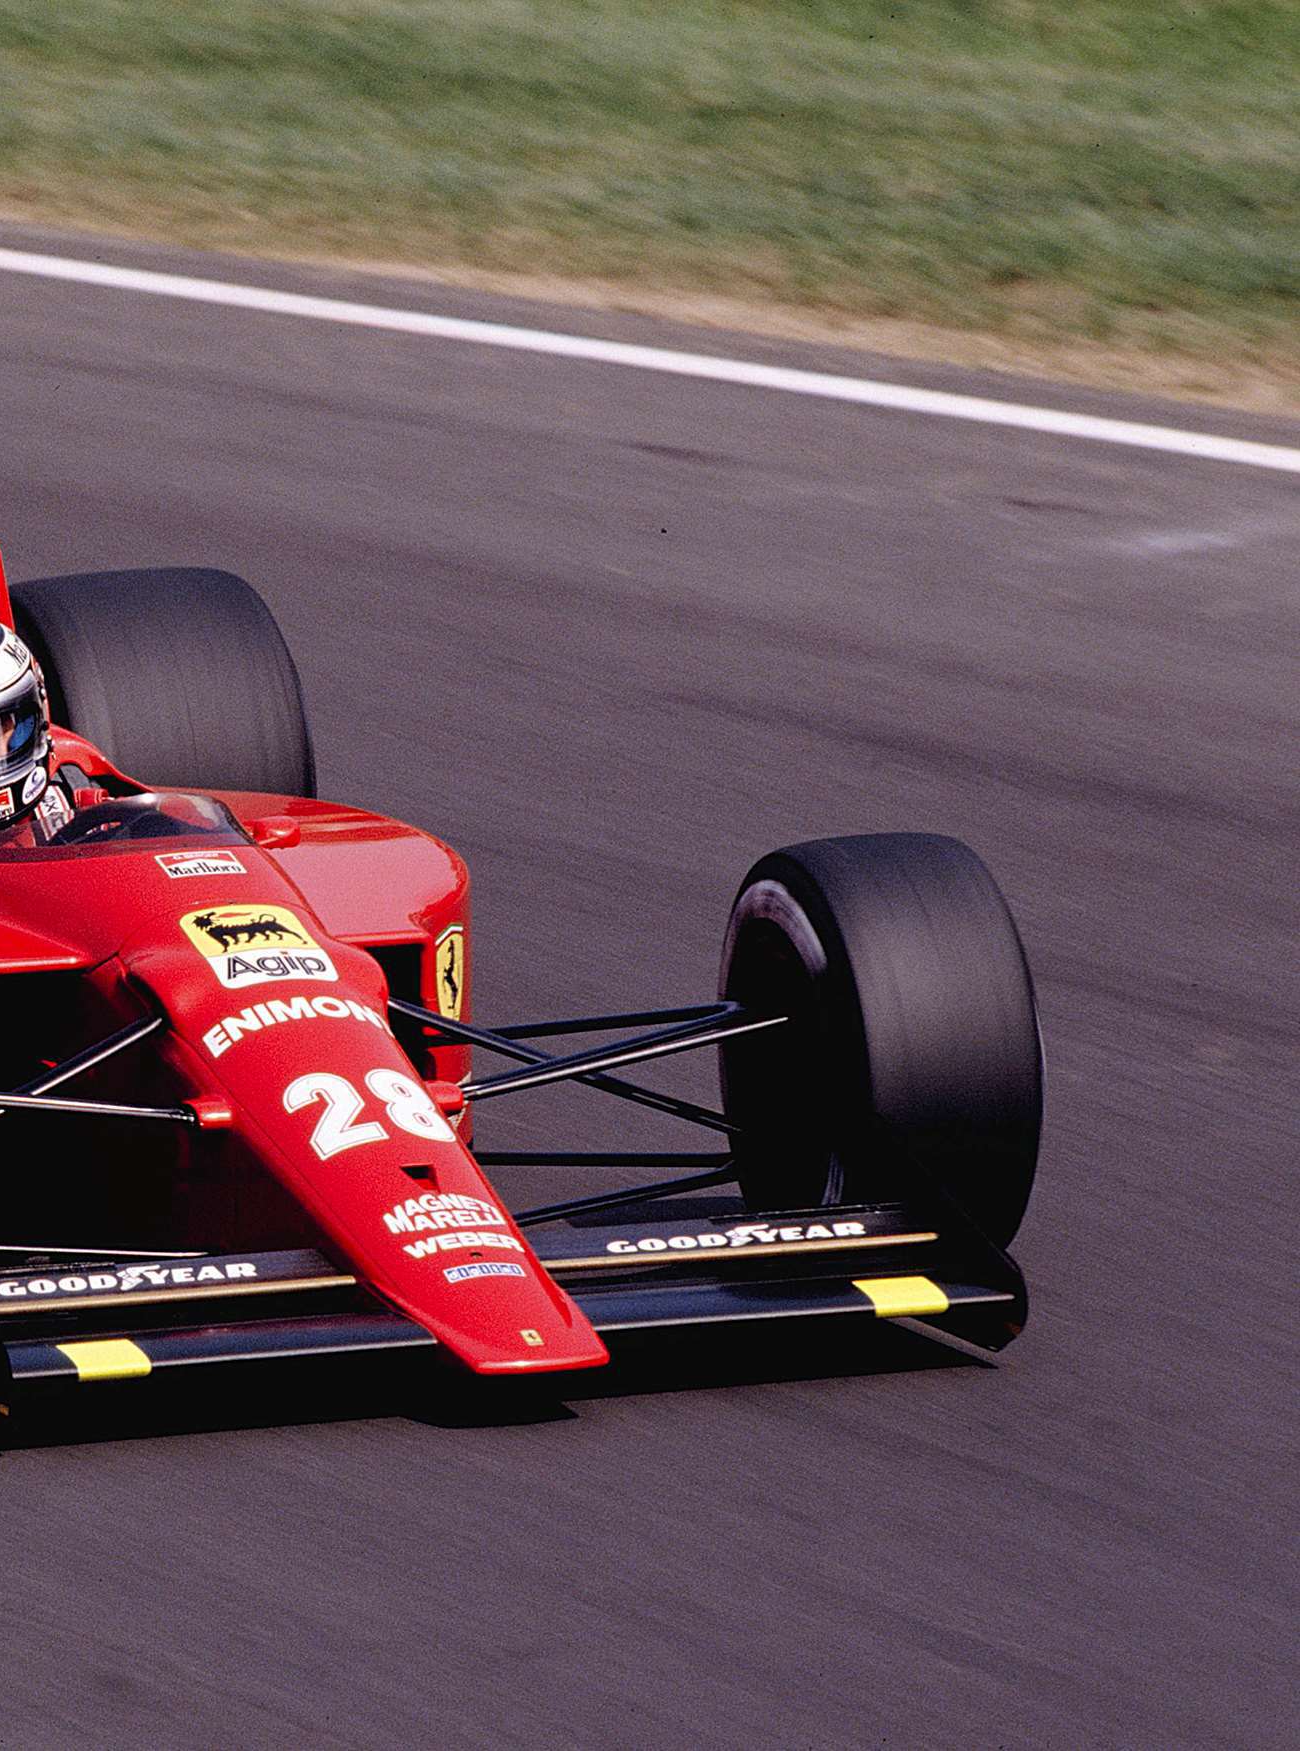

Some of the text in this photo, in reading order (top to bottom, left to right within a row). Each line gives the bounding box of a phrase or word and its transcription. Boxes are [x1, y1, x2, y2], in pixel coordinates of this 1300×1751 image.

[167, 861, 242, 876] Marlboro
[227, 951, 327, 980] Agip
[283, 1068, 457, 1161] 28
[403, 1231, 526, 1259] WEBER
[606, 1222, 867, 1253] GOODYEAR
